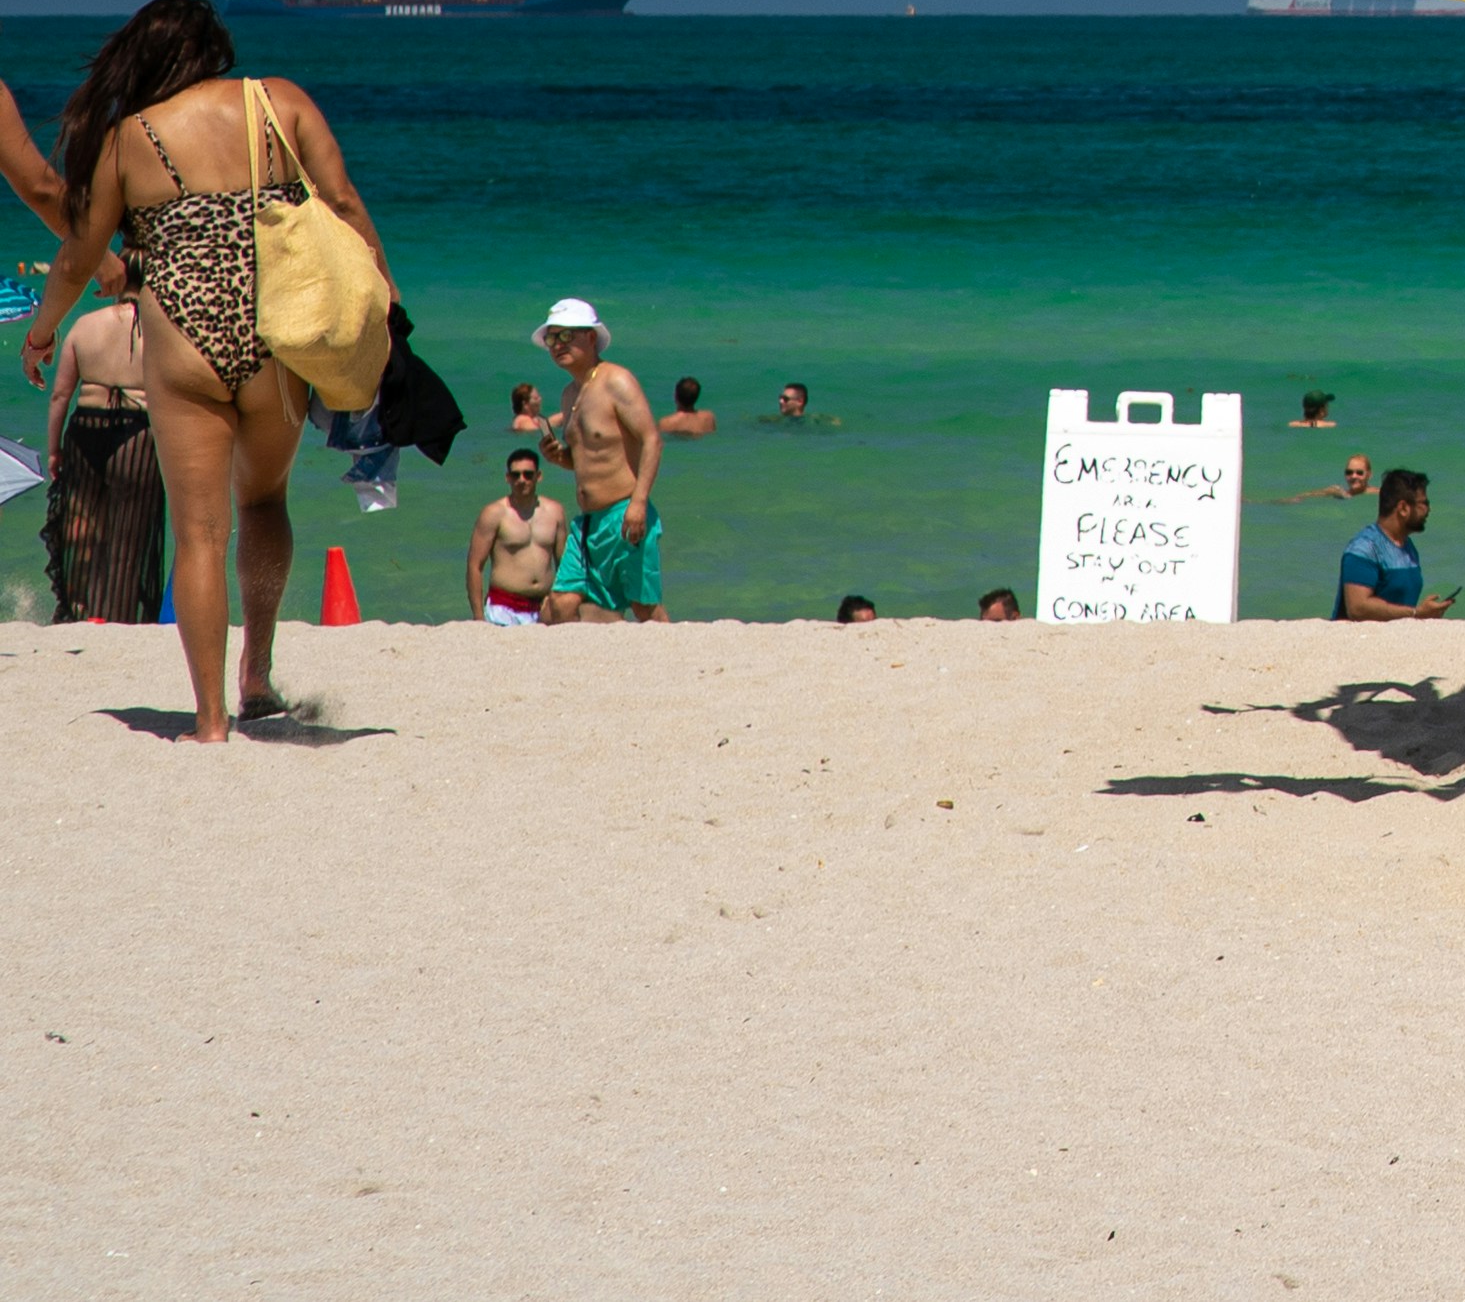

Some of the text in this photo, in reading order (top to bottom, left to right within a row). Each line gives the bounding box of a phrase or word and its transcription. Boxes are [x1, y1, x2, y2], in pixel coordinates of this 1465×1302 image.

[1054, 443, 1222, 501] EMERGENCY
[1077, 513, 1190, 548] PLEASE
[1067, 552, 1124, 582] STAY
